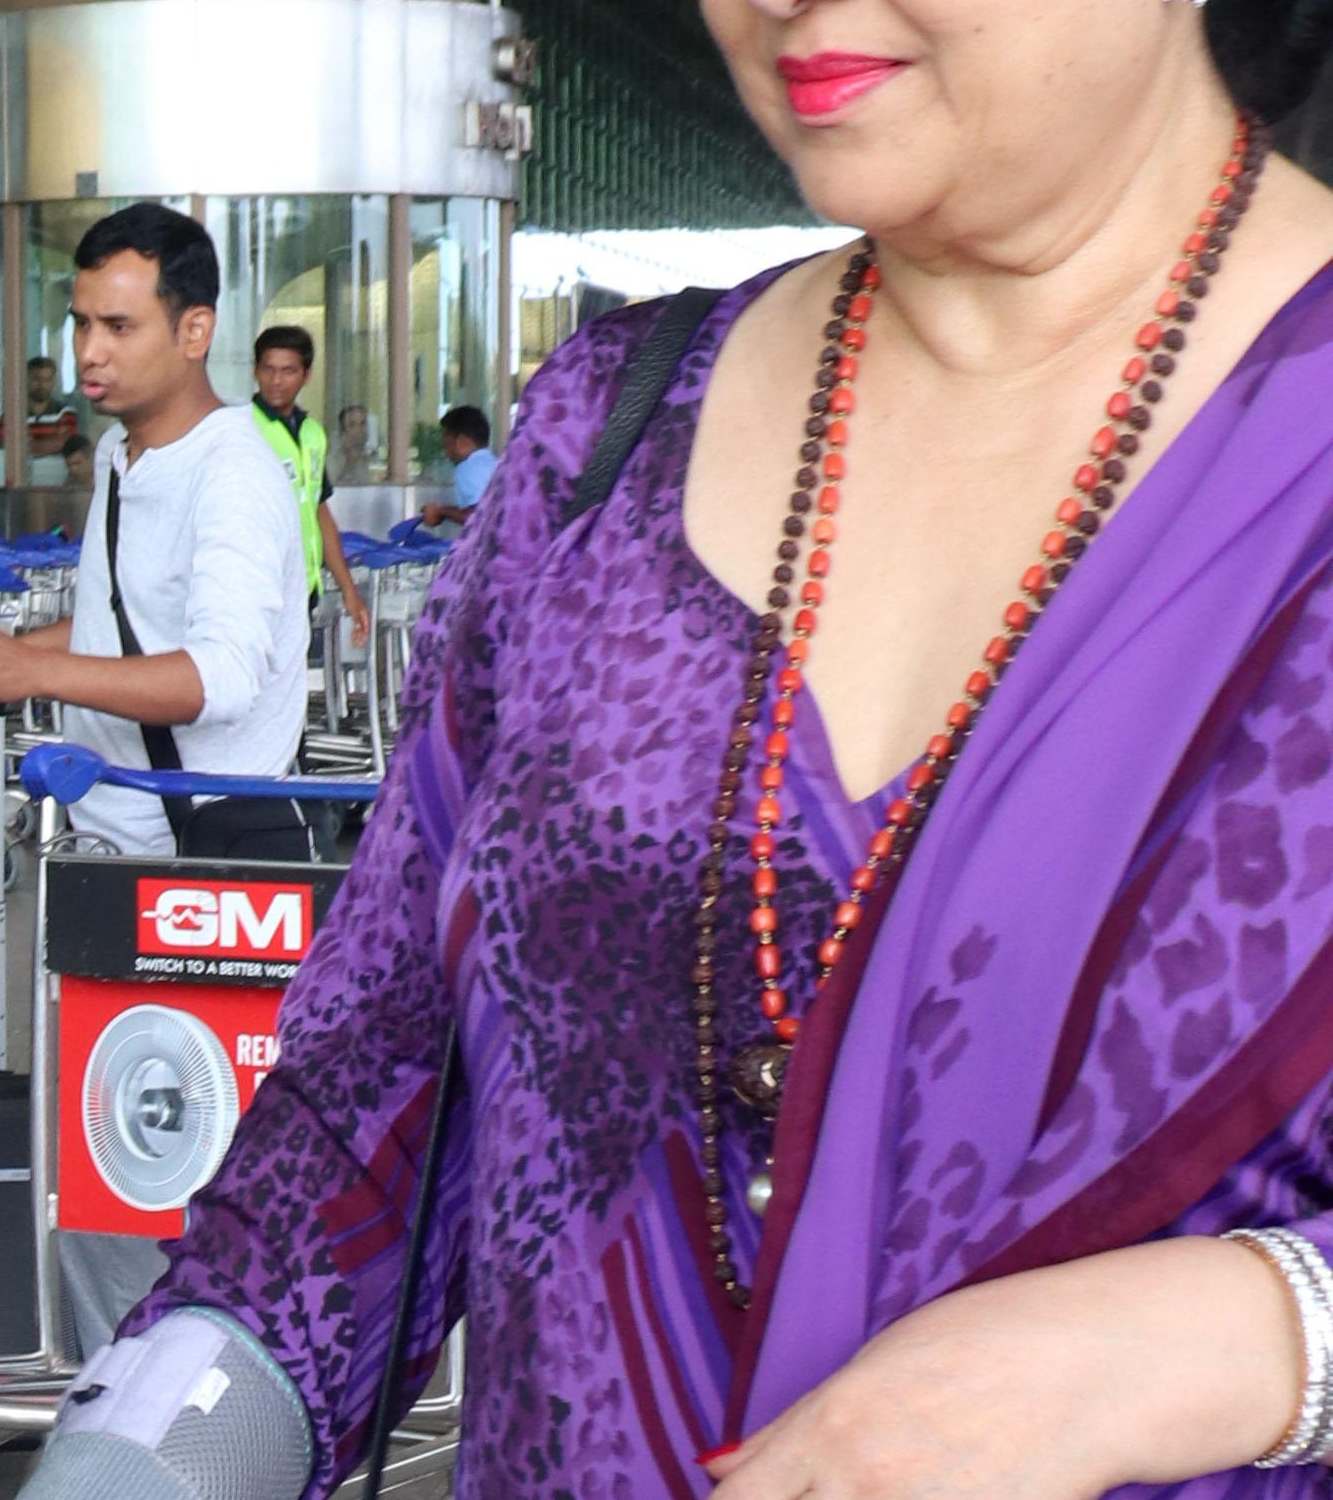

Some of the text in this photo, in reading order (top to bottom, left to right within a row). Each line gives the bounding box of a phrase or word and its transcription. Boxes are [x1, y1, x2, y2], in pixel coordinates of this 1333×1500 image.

[141, 888, 303, 951] GM
[134, 956, 184, 974] SWITCH
[186, 959, 206, 975] TO
[206, 960, 218, 975] A
[218, 960, 263, 978] BETTER
